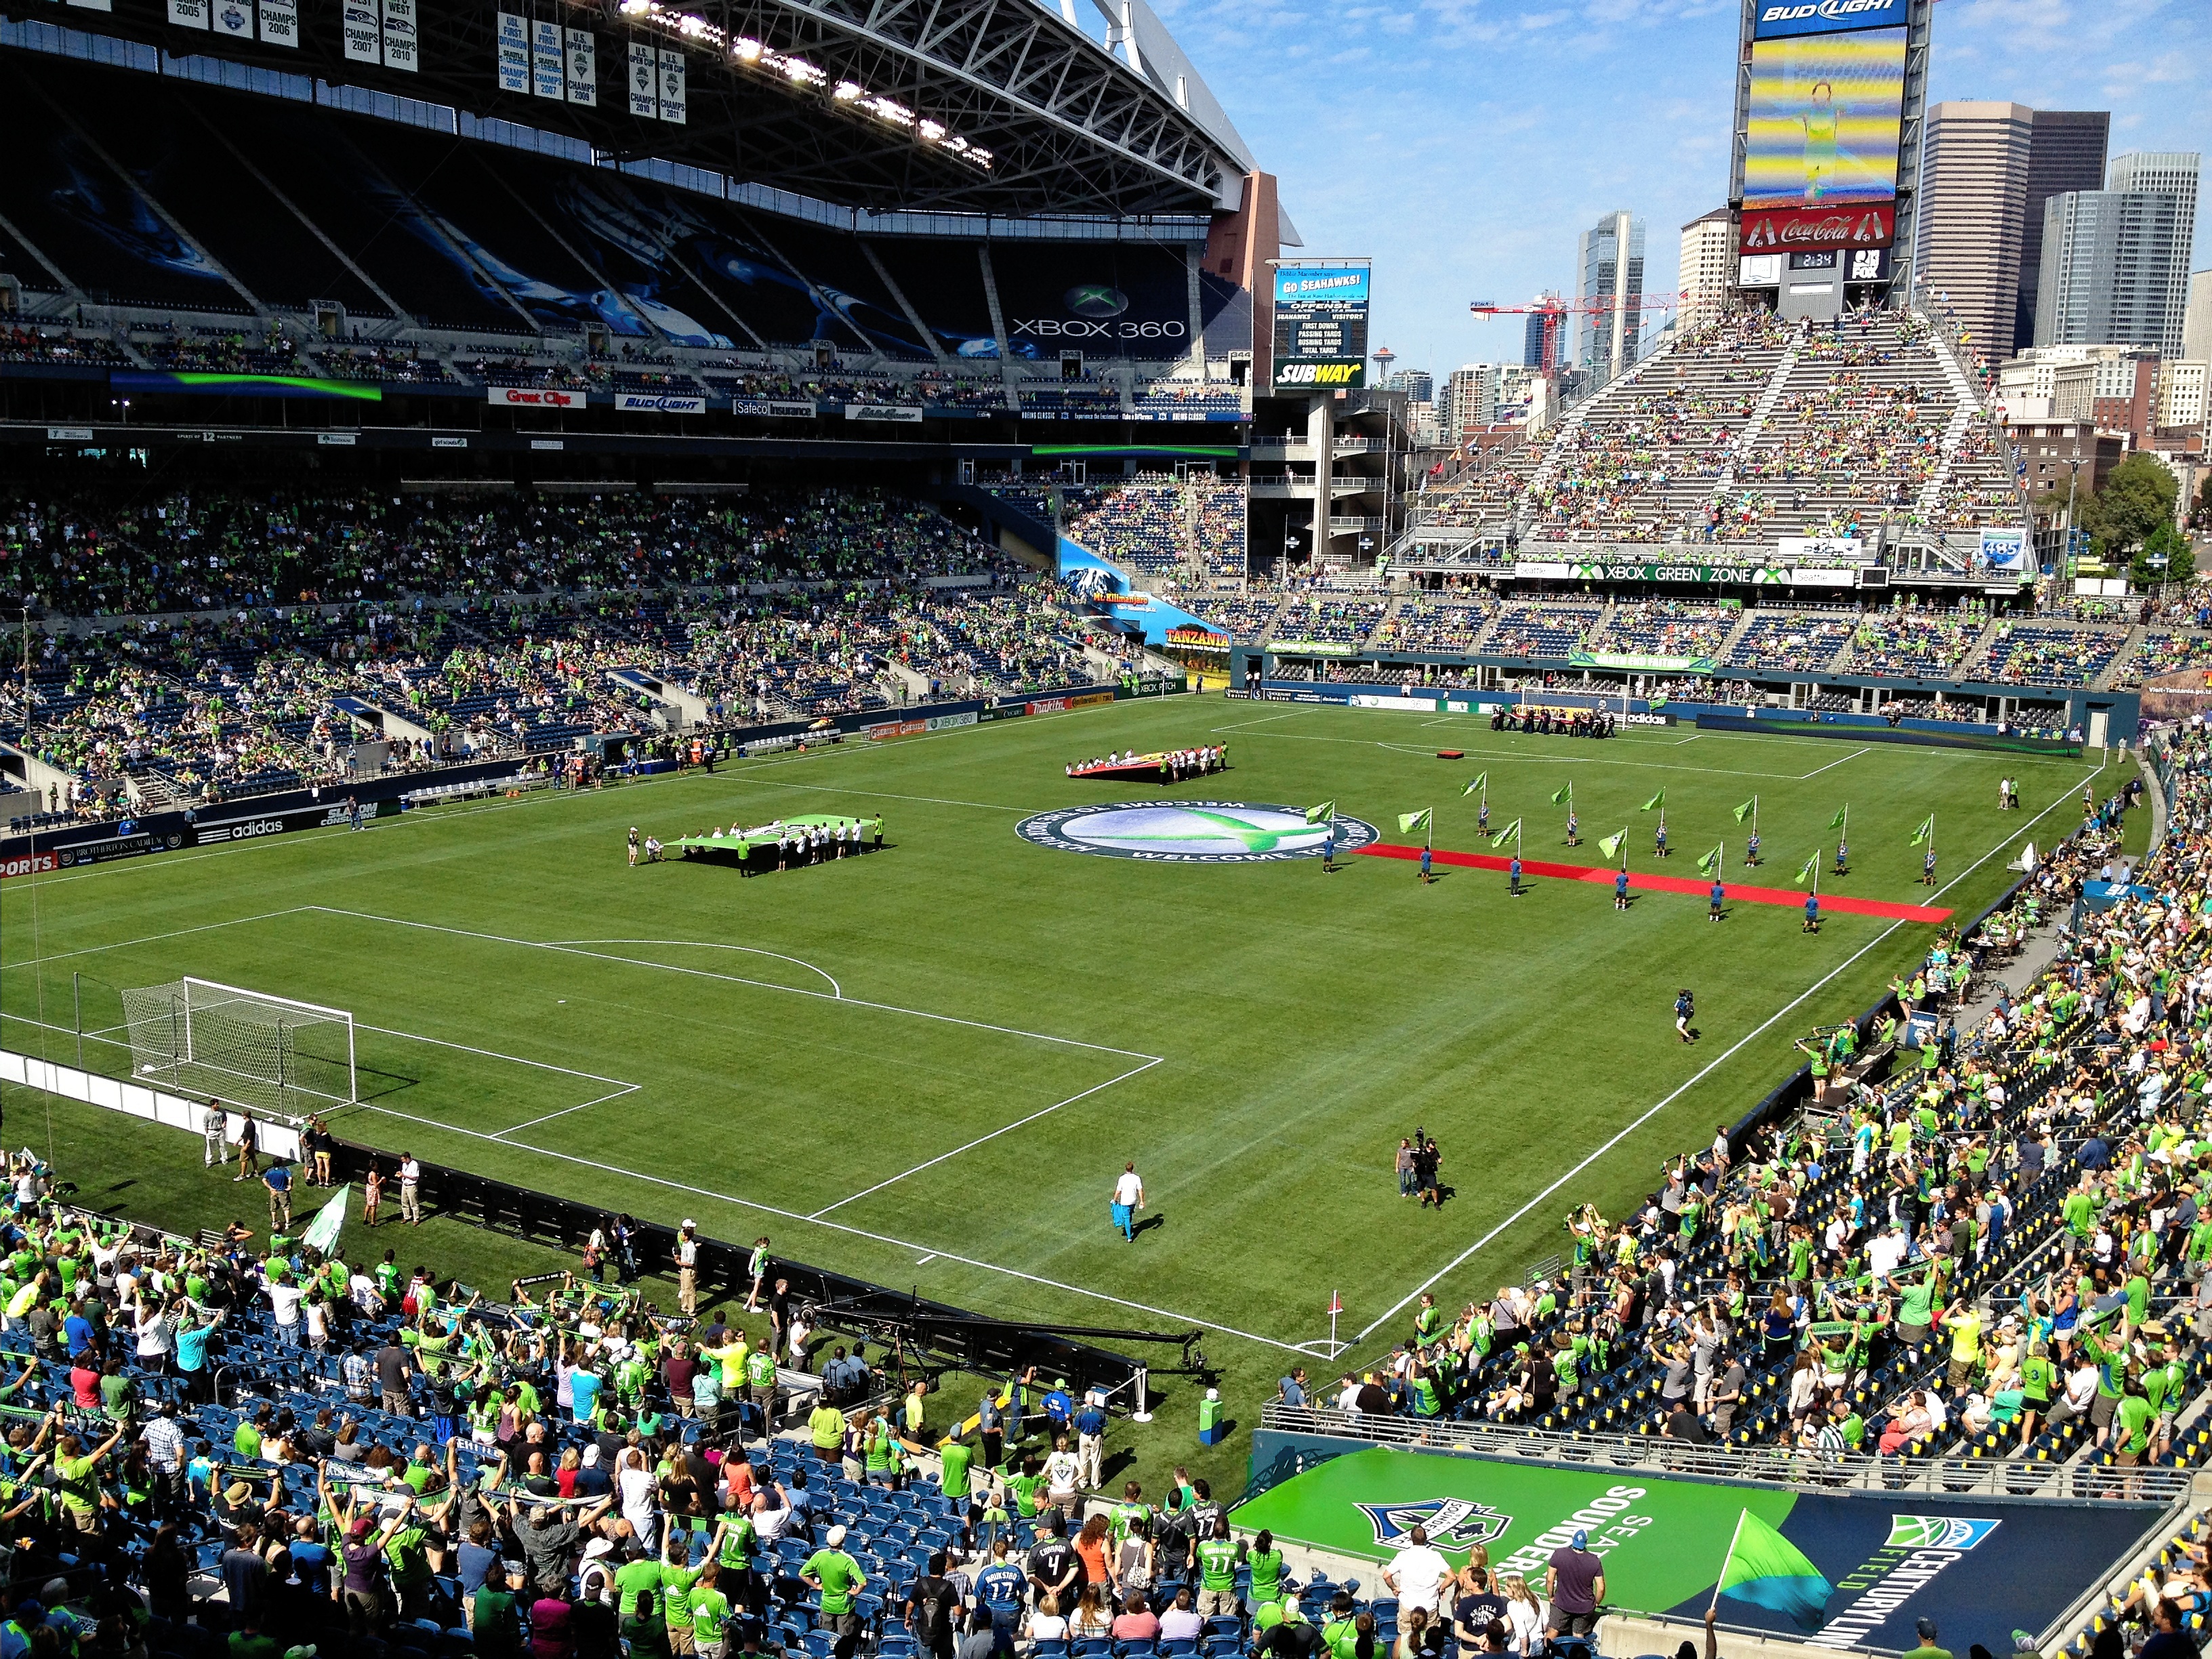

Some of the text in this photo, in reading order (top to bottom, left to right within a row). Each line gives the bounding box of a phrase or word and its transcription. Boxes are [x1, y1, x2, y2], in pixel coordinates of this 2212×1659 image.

[176, 3, 199, 18] 2005
[389, 1, 410, 15] WEST
[1762, 0, 1893, 22] BUD LIGHT
[261, 9, 296, 26] CHAMPS
[506, 16, 519, 27] USL
[268, 22, 289, 35] 2006
[345, 27, 378, 43] CHAMPS
[504, 26, 523, 39] FIRST
[385, 36, 416, 52] CHAMPS
[499, 36, 527, 50] DIVISION
[538, 34, 556, 45] FIRST
[573, 33, 587, 44] U.S.
[352, 40, 372, 52] 2007
[534, 43, 562, 57] DIVISION
[567, 41, 594, 53] OPEN CUP
[636, 47, 648, 58] U.S.
[392, 49, 410, 61] 2010
[630, 54, 655, 66] OPEN CUP
[665, 53, 678, 64] U.S.
[500, 66, 528, 79] CHAMPS
[659, 61, 684, 73] OPEN CUP
[506, 77, 523, 88] 2005
[535, 73, 562, 86] CHAMPS
[541, 85, 556, 95] 2007
[568, 80, 595, 94] CHAMPS
[575, 91, 590, 101] 2009
[630, 93, 655, 106] CHAMPS
[636, 103, 649, 113] 2010
[661, 99, 685, 112] CHAMPS
[667, 109, 679, 119] 2011
[1780, 216, 1855, 243] Coca-Cola
[1803, 253, 1832, 267] 2:34
[1851, 266, 1879, 279] FOX
[1283, 274, 1361, 293] GO SEAHAWKS!
[1012, 319, 1186, 338] XBOX 360
[1275, 363, 1362, 384] SUBWAY
[506, 390, 571, 407] Great Clips
[624, 397, 699, 410] BUD LIGHT
[737, 401, 811, 417] Safeco Insurance
[203, 432, 215, 442] 12
[1655, 567, 1701, 581] GREEN
[1709, 568, 1750, 583] ZONE
[1106, 593, 1148, 606] Kilimanjaro
[1165, 629, 1230, 647] TANZANIA
[1313, 644, 1335, 652] GREEN
[1595, 655, 1689, 668] NORTH END FAITHFUL
[1033, 701, 1065, 715] Makita
[1410, 699, 1428, 710] 360
[940, 714, 972, 727] XBOX 360
[1628, 713, 1666, 725] adidas
[327, 802, 378, 819] SLAOM
[1113, 800, 1245, 809] WELCOME
[320, 811, 376, 826] CONSUING
[1037, 811, 1080, 825] THE
[232, 819, 283, 838] adidas
[1025, 821, 1051, 836] XBOX
[76, 836, 165, 857] BROTHERTON CADILLAC
[1033, 836, 1099, 853] PITCH
[1132, 852, 1292, 862] WELCOME
[1295, 847, 1326, 856] TO
[380, 1269, 386, 1284] 8
[752, 1365, 762, 1380] 10
[1197, 1518, 1216, 1537] 17
[1048, 1555, 1060, 1576] 4
[1837, 1549, 1908, 1590] FIELD
[991, 1581, 1014, 1601] 17
[1803, 1550, 1963, 1650] CENTURYLIN
